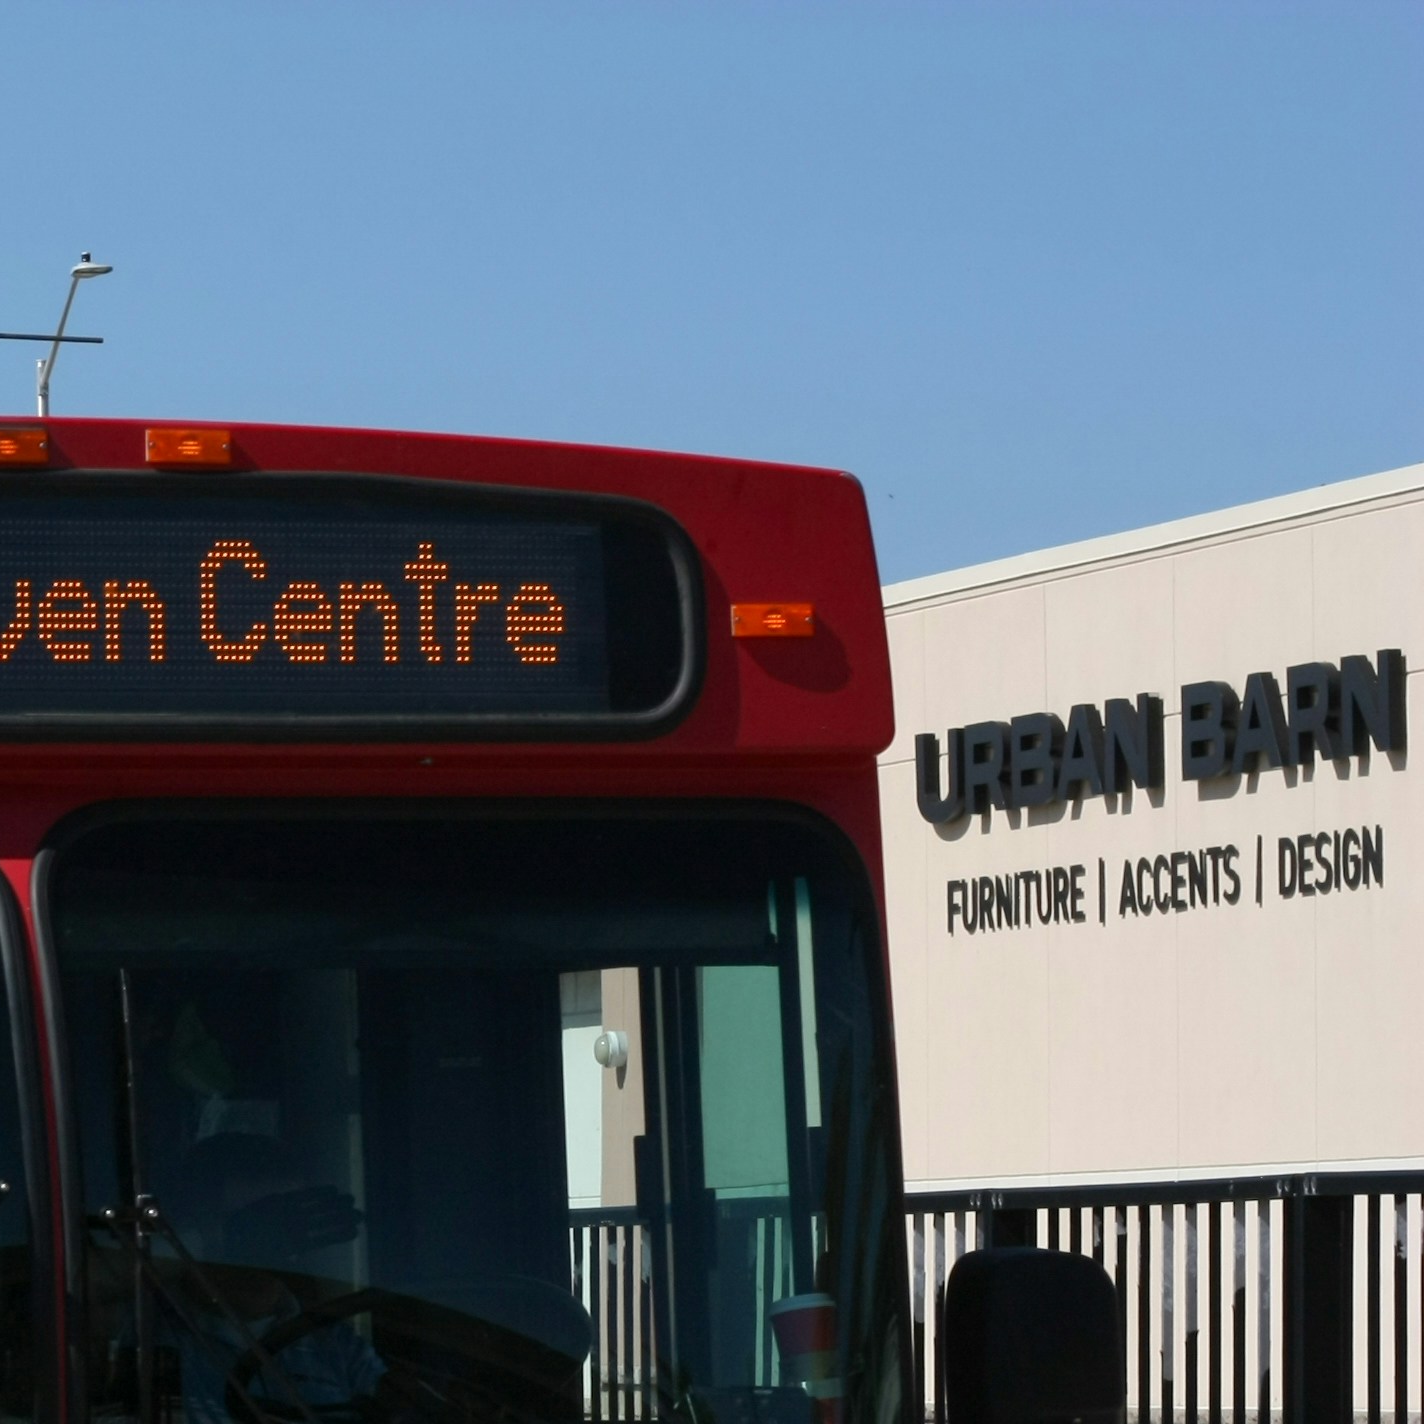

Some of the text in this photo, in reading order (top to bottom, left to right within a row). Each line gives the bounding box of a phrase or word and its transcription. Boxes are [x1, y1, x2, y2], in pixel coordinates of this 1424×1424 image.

[200, 538, 566, 664] Centre
[915, 649, 1406, 824] URBAN BARN
[947, 825, 1384, 934] FURNITURE ACCENTS DESIGN
